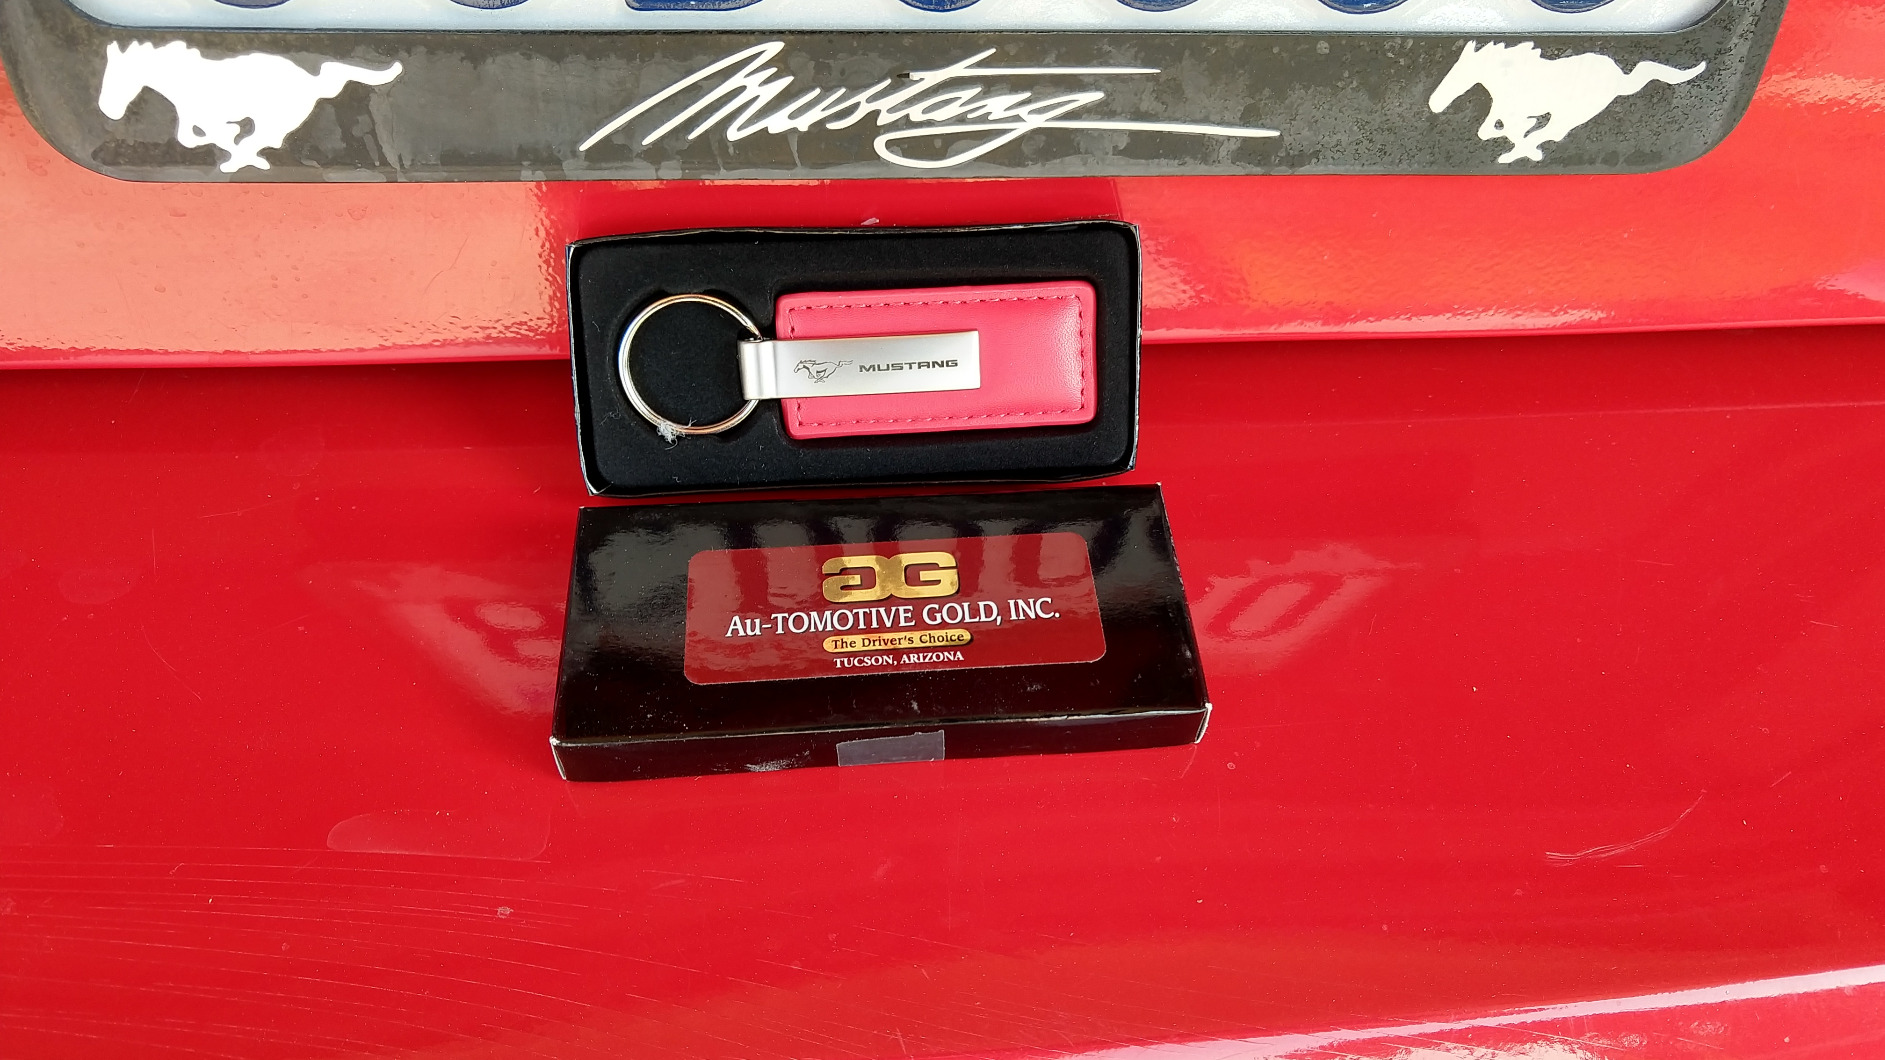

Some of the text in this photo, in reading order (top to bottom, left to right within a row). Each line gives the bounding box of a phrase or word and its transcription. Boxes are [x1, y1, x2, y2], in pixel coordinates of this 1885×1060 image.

[579, 40, 1280, 168] Mustang
[859, 359, 959, 373] MUSTANG
[725, 597, 1061, 638] Au-TOMOTIVE GOLD, INC.
[831, 631, 966, 650] The Driver's Choice
[833, 650, 965, 668] TUCSON, ARIZONA
